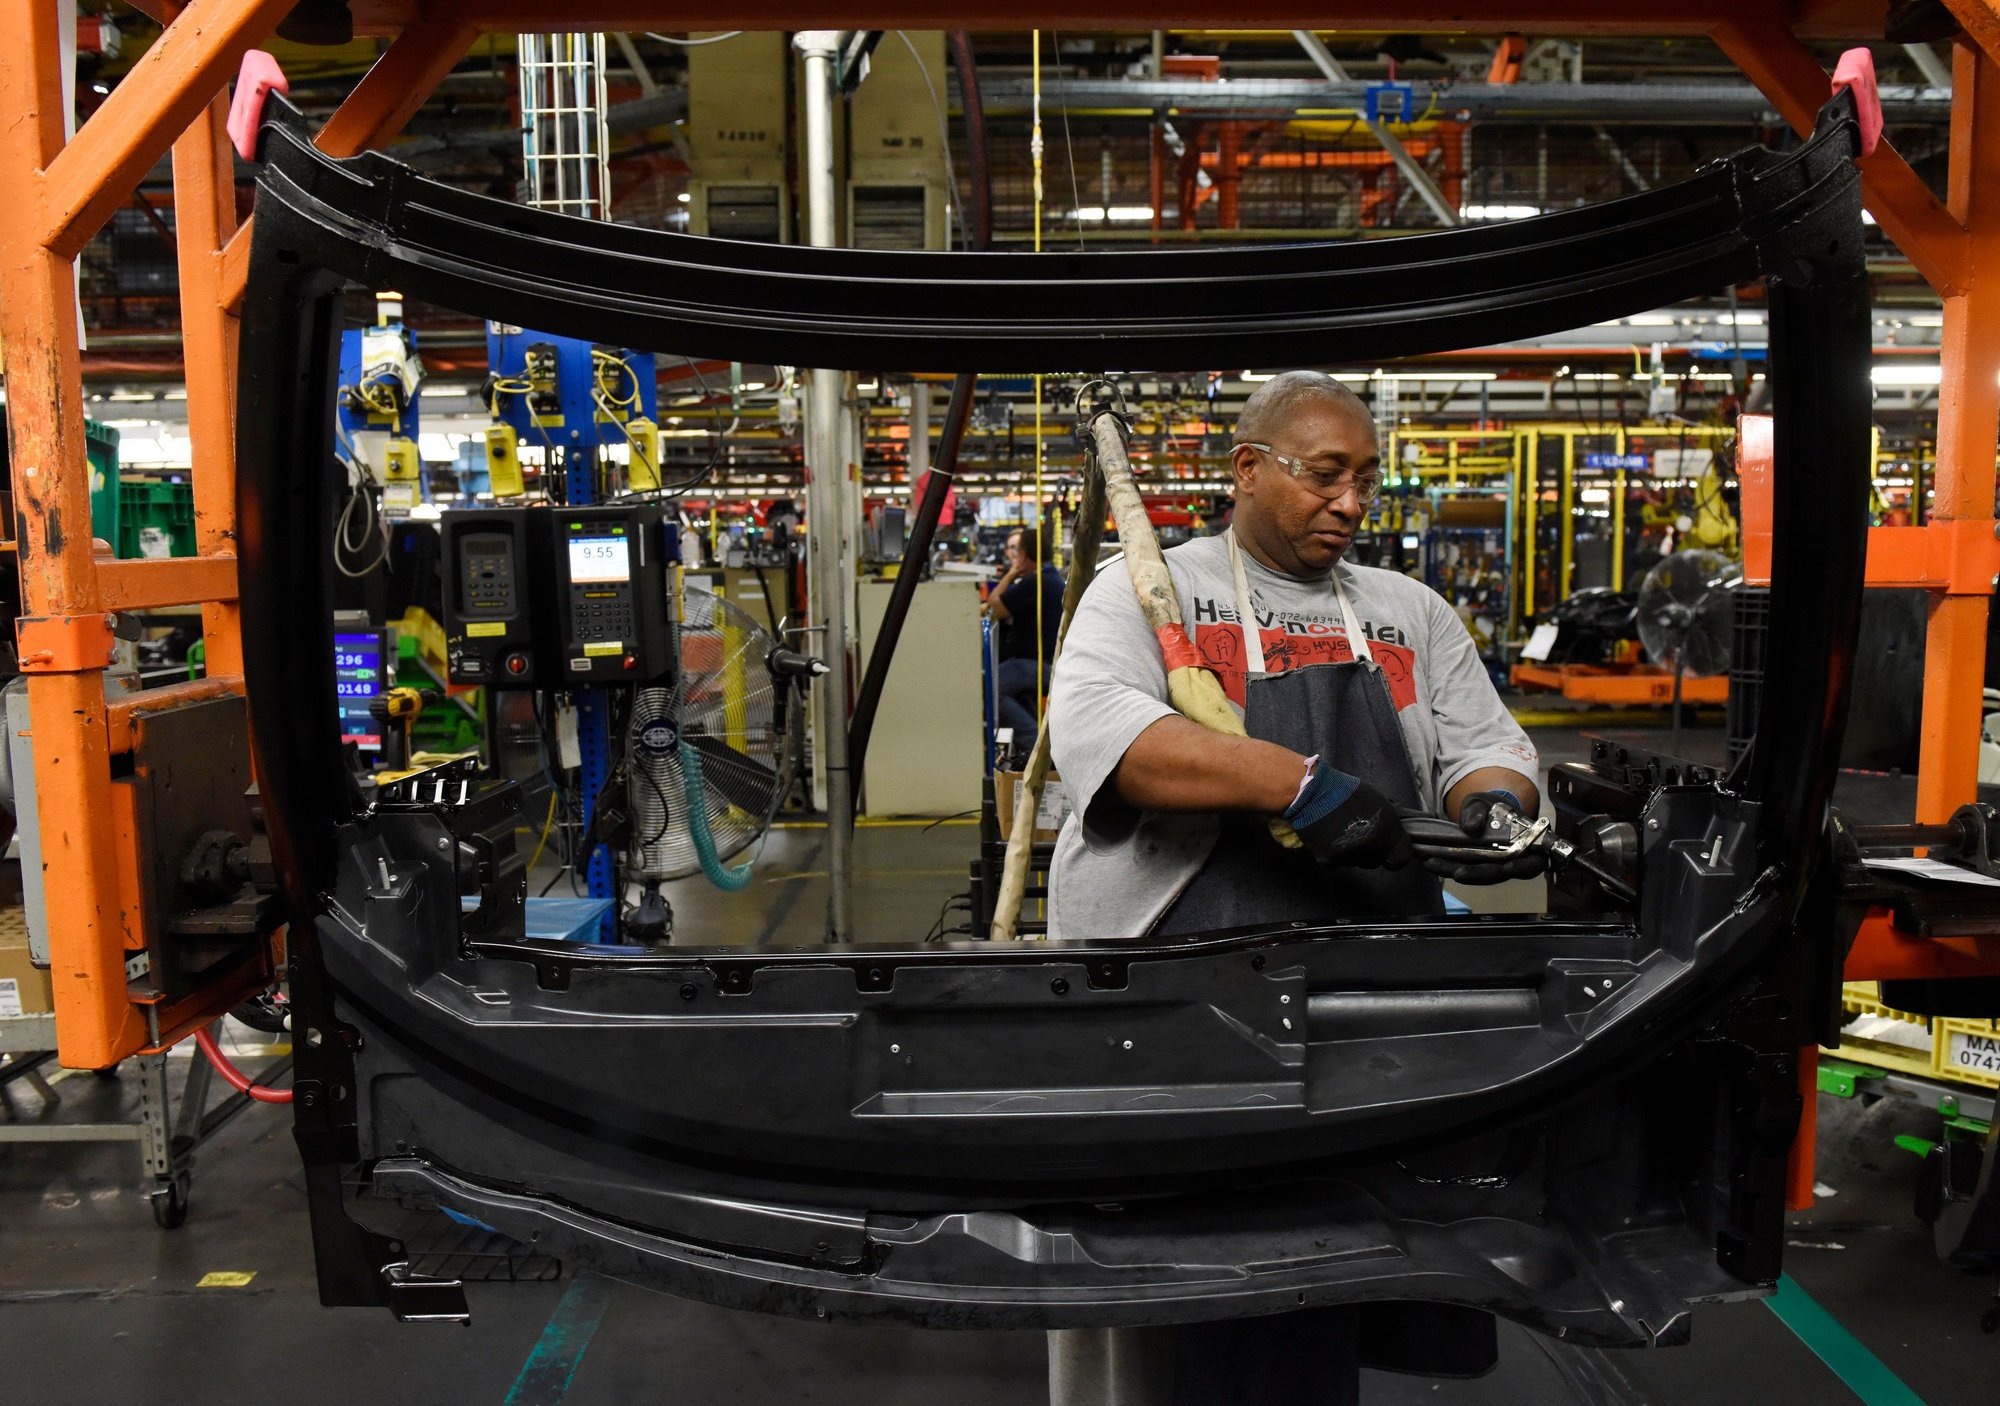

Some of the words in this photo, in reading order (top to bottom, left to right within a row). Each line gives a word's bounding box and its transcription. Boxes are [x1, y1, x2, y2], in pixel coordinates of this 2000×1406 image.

[583, 546, 613, 558] 9.55
[336, 654, 363, 665] 296
[337, 684, 372, 694] 0148
[1967, 1034, 2000, 1054] MA
